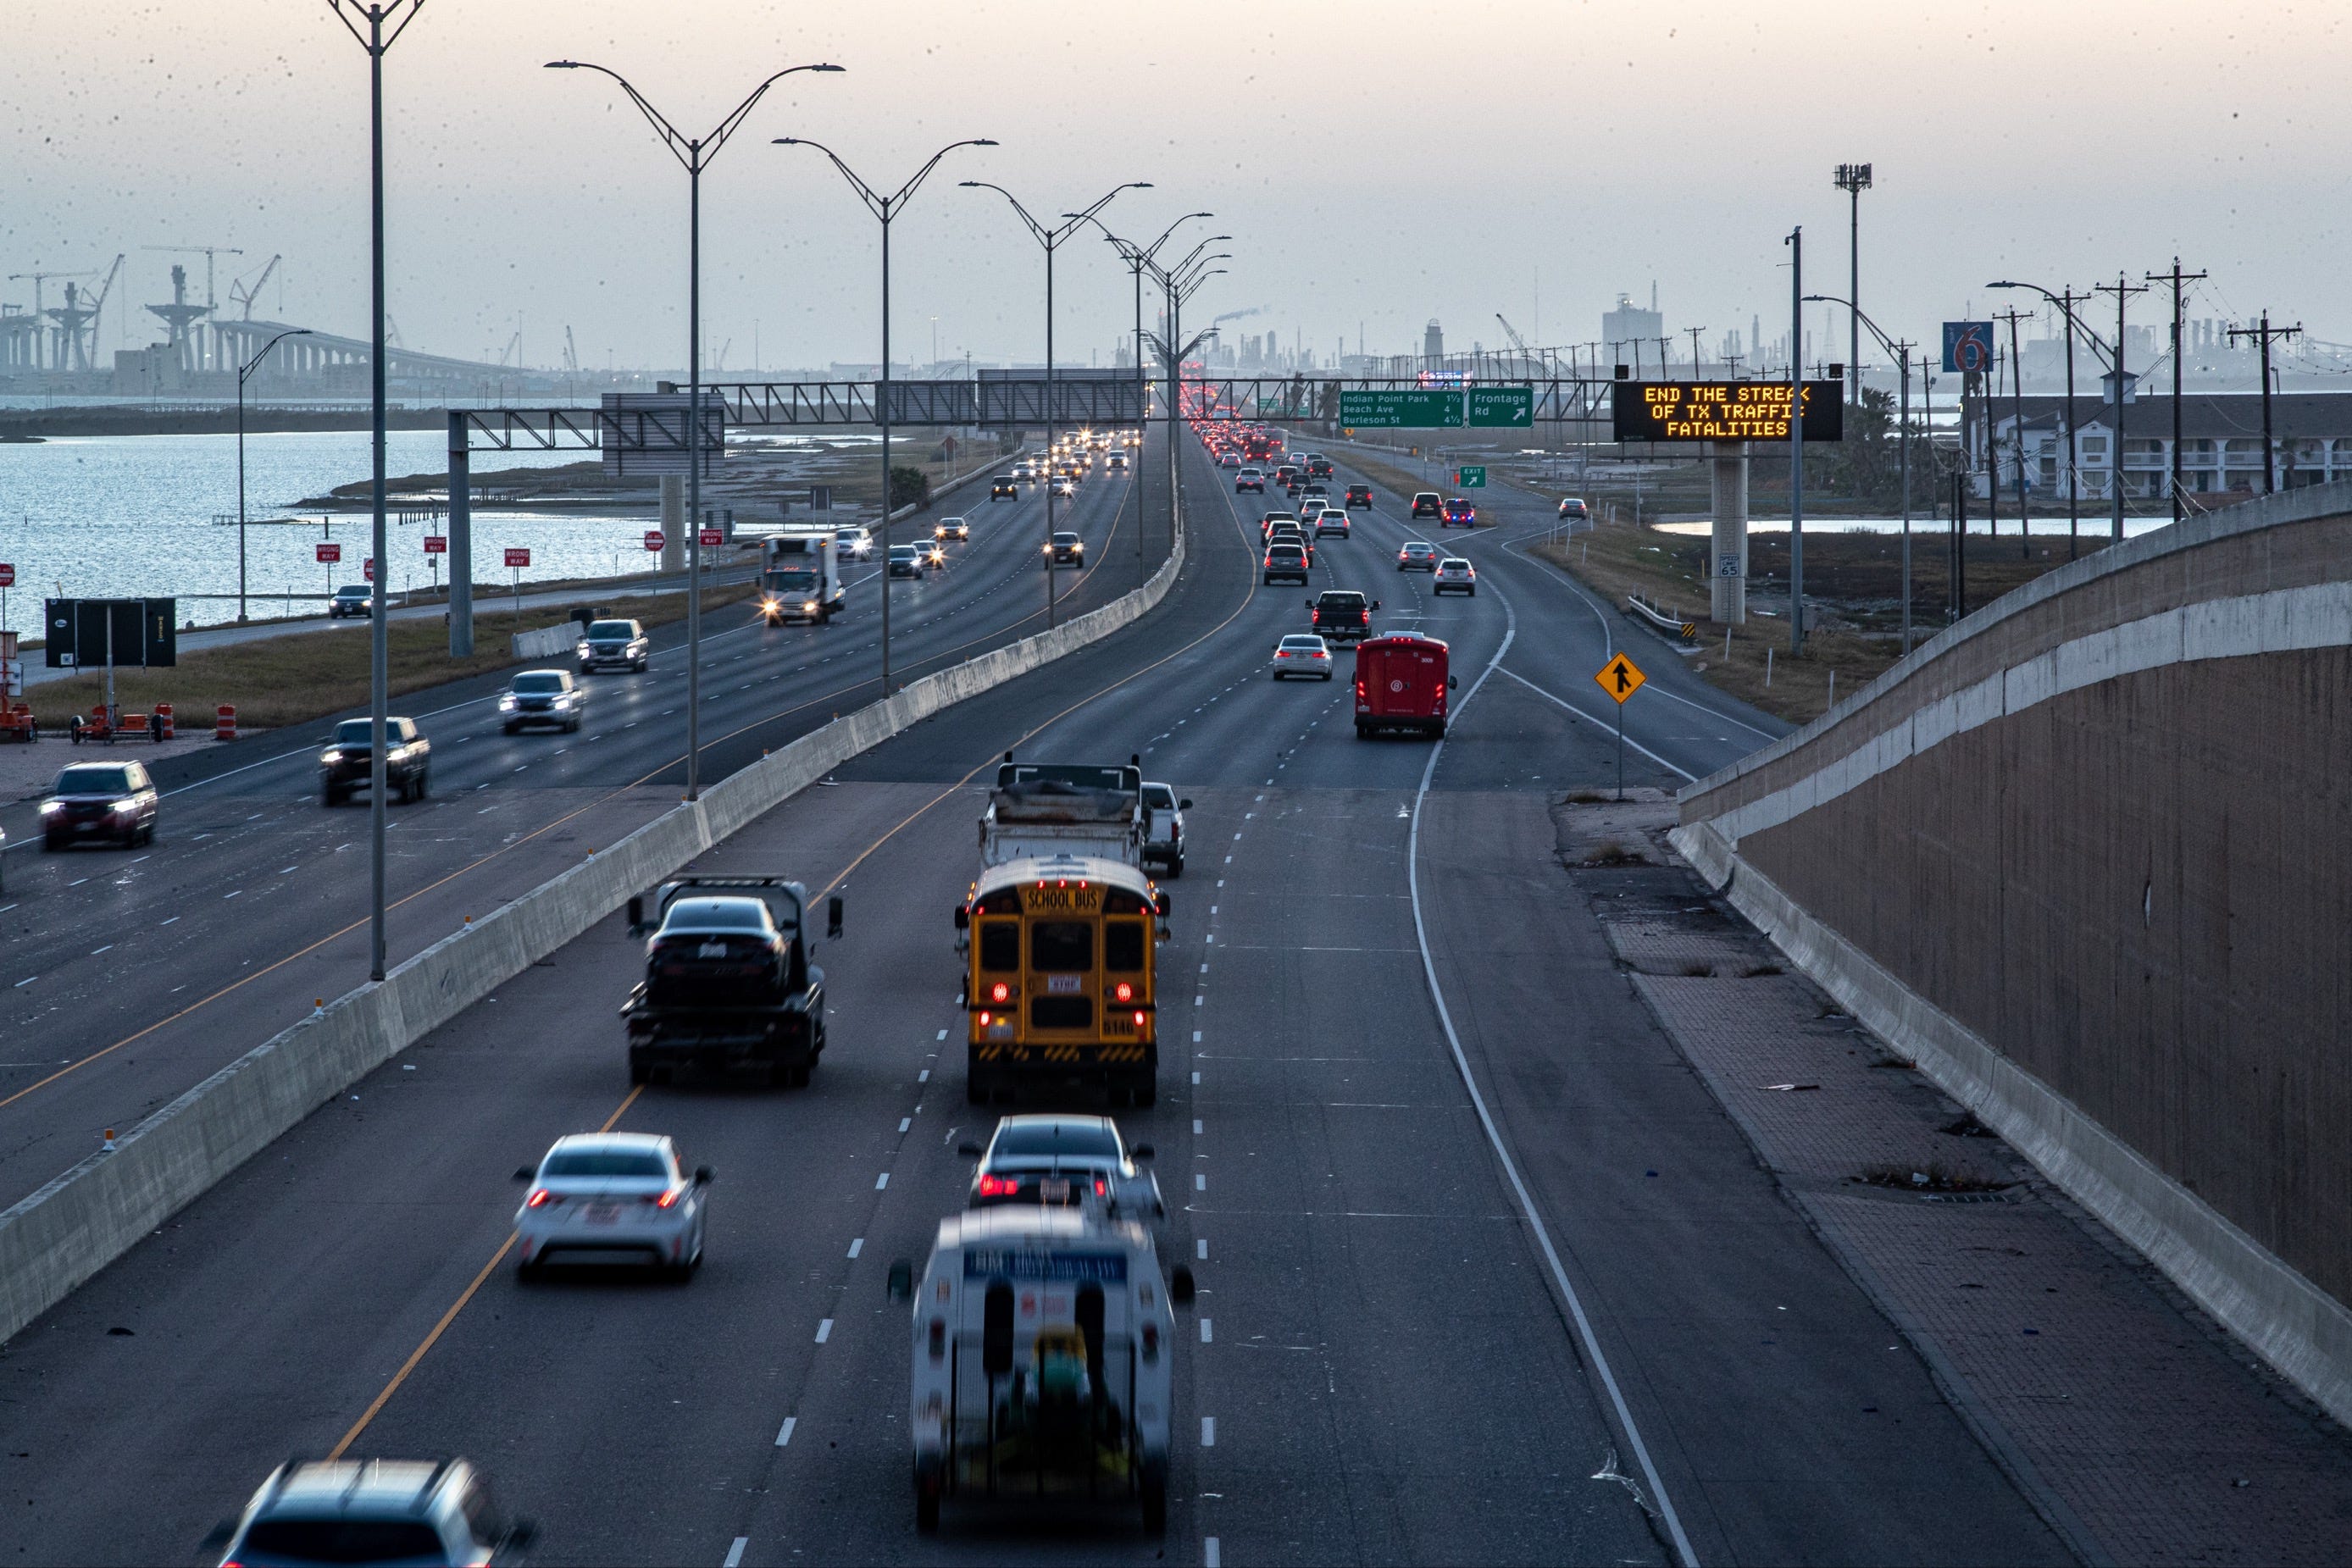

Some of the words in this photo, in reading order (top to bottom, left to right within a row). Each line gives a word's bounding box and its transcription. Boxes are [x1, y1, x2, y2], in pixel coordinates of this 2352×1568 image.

[1954, 325, 1986, 371] 6
[1475, 395, 1526, 403] Frontage
[1645, 387, 1681, 402] END
[1692, 387, 1727, 402] THE
[1652, 404, 1675, 418] OF
[1686, 404, 1710, 418] TX
[1721, 404, 1806, 418] TRAFFI
[1667, 422, 1788, 435] FATALITIES
[1722, 567, 1737, 575] 65
[1028, 890, 1072, 908] SCHOOL
[1075, 890, 1097, 908] BUS
